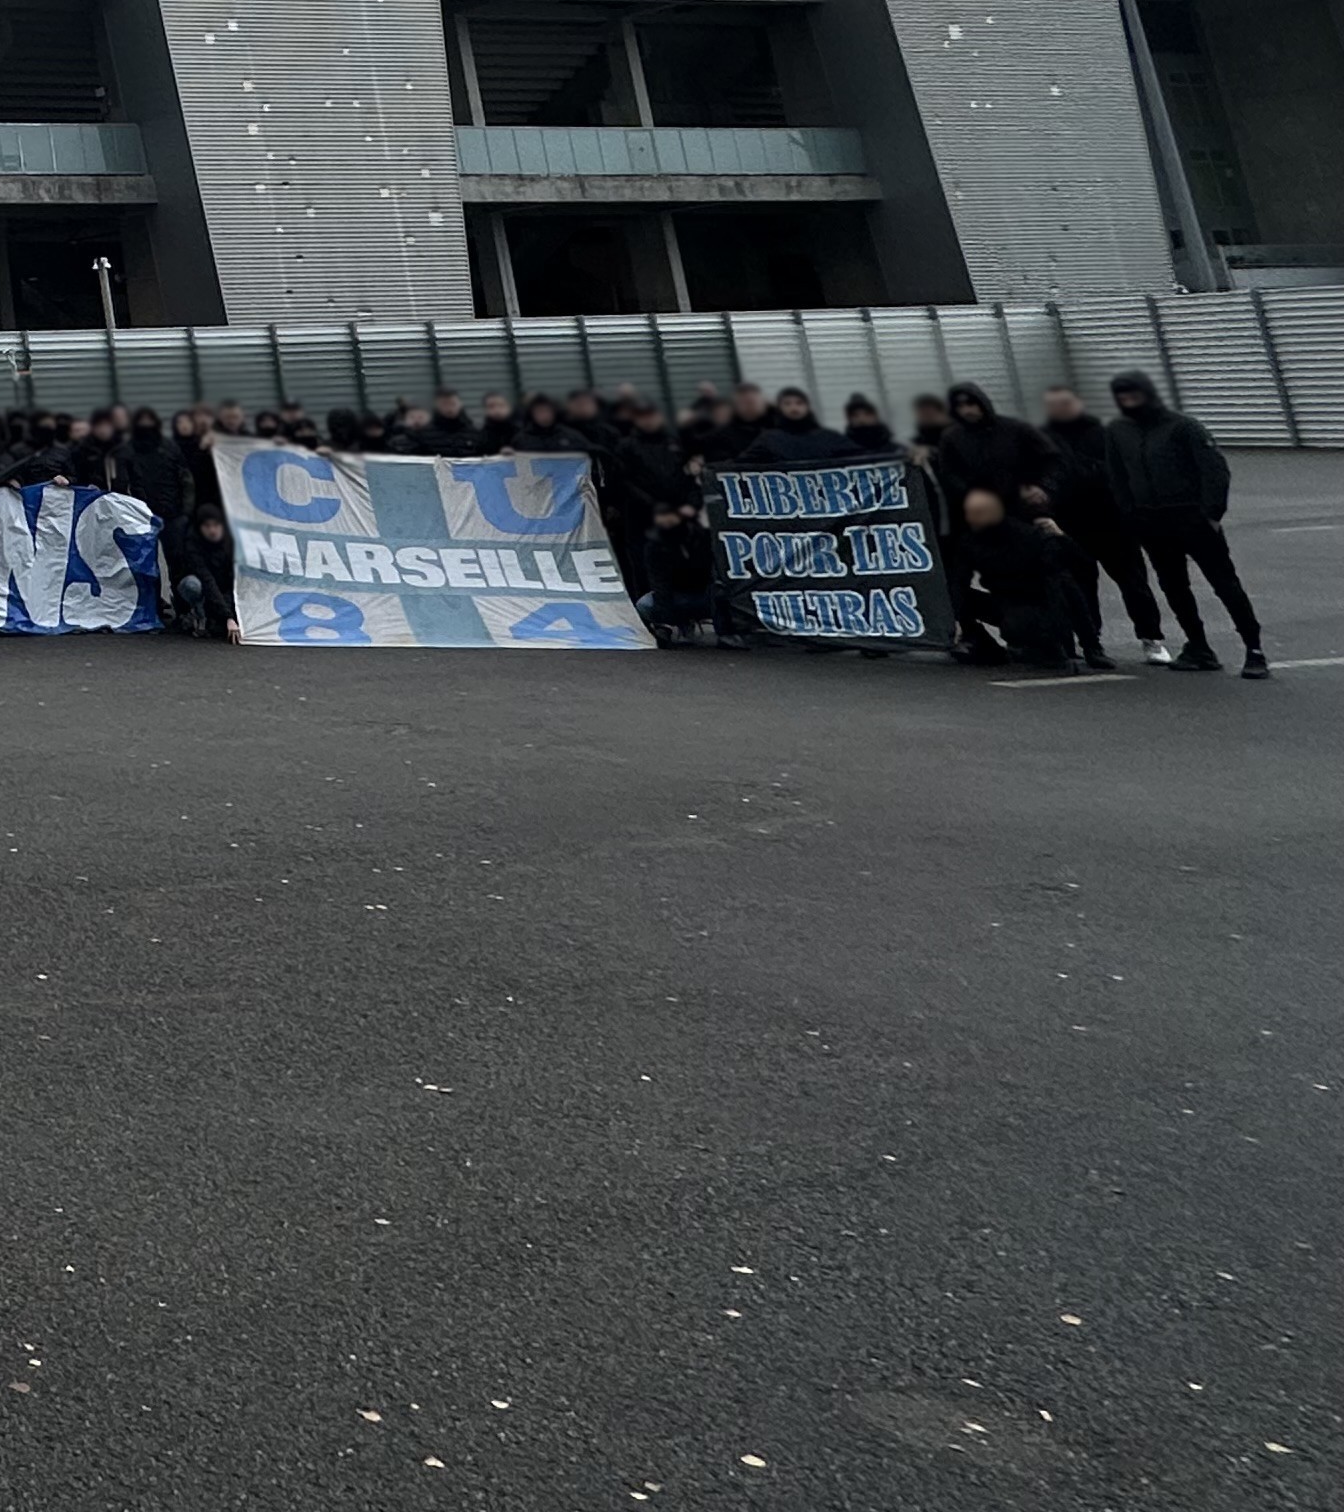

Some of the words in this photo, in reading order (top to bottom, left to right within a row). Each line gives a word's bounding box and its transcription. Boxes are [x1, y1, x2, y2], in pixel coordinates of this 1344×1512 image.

[237, 526, 626, 593] MARSEILLE
[718, 531, 848, 580] POUR
[843, 522, 934, 576] LES
[751, 587, 925, 638] ULTRAS
